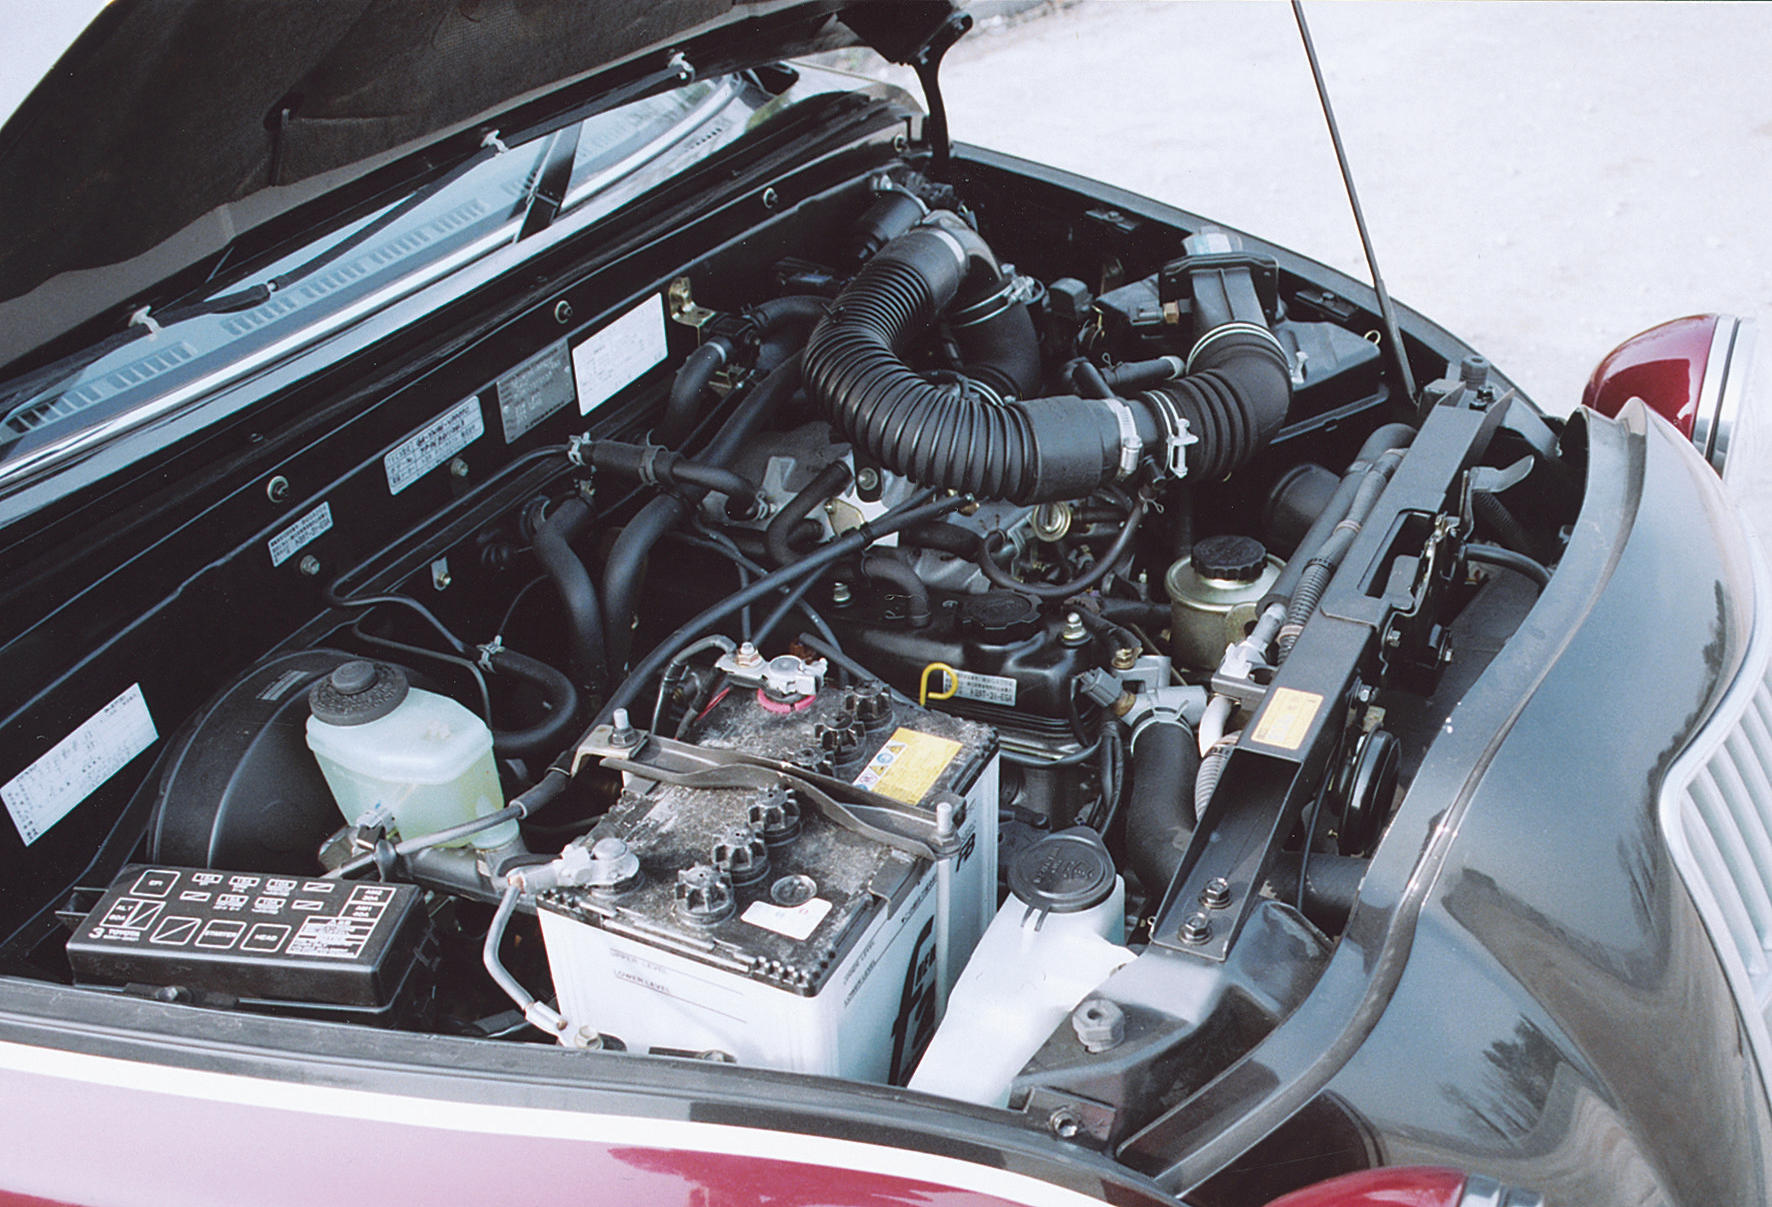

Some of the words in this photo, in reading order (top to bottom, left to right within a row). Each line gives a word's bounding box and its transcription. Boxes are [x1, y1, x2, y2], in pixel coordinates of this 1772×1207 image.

[115, 904, 134, 912] ALT
[88, 926, 106, 939] 3
[204, 929, 238, 938] STARTER
[254, 933, 279, 942] HEAD
